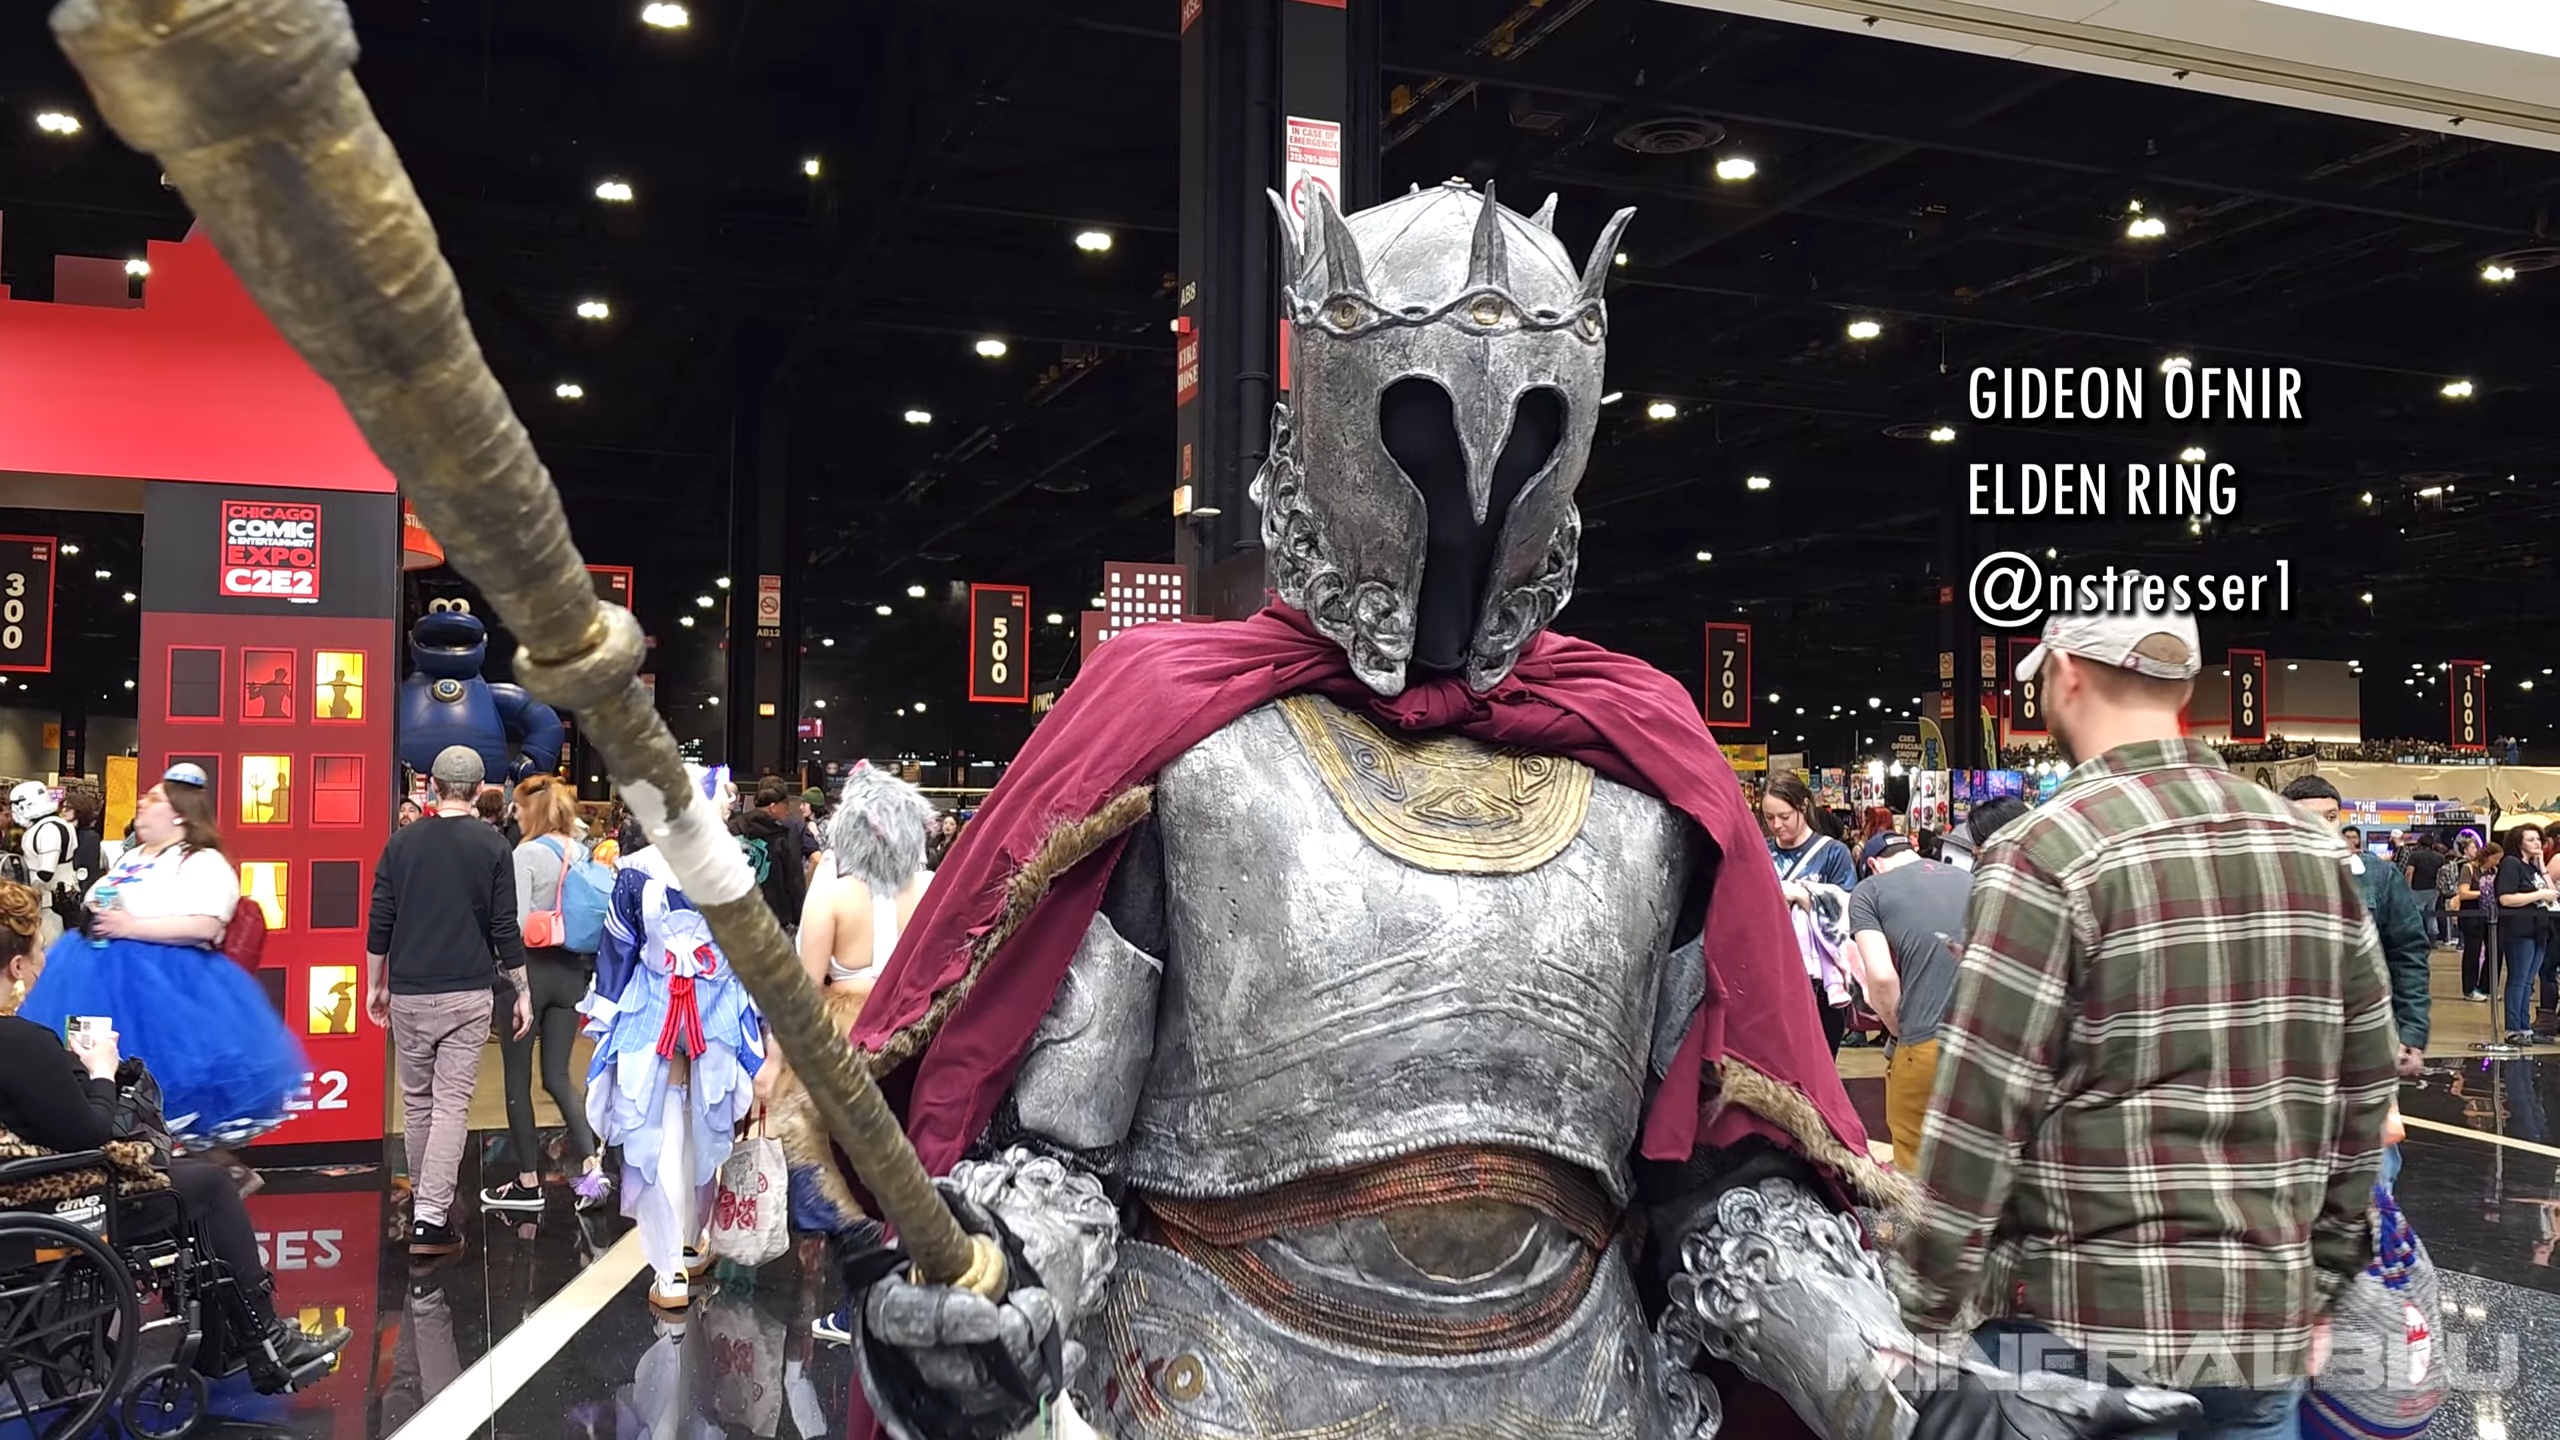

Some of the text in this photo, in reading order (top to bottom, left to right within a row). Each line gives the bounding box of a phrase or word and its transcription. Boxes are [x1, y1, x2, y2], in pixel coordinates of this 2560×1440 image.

[1289, 135, 1338, 149] EMERGENCY
[1291, 127, 1336, 140] IN CASE OF
[1180, 281, 1196, 308] AB8
[1179, 341, 1198, 369] FIRE
[1178, 363, 1199, 393] HOSE
[228, 505, 315, 521] CHICAGO
[228, 519, 315, 539] COMIC
[228, 536, 314, 548] & ENTERTAINMENT
[228, 546, 314, 567] EXPO
[225, 568, 313, 595] C2E2
[2, 573, 26, 650] 300
[757, 628, 781, 637] AB12
[992, 617, 1008, 684] 500
[1722, 650, 1735, 709] 700
[2023, 674, 2036, 719] 00
[2242, 673, 2253, 726] 900
[2463, 674, 2474, 742] 1000
[1891, 743, 1924, 751] OFFICIAL
[2354, 801, 2377, 812] THE
[2415, 803, 2436, 812] CUT
[2350, 813, 2381, 824] CLAW
[2408, 815, 2420, 825] TO
[282, 1070, 348, 1110] E2
[55, 1194, 101, 1213] drive
